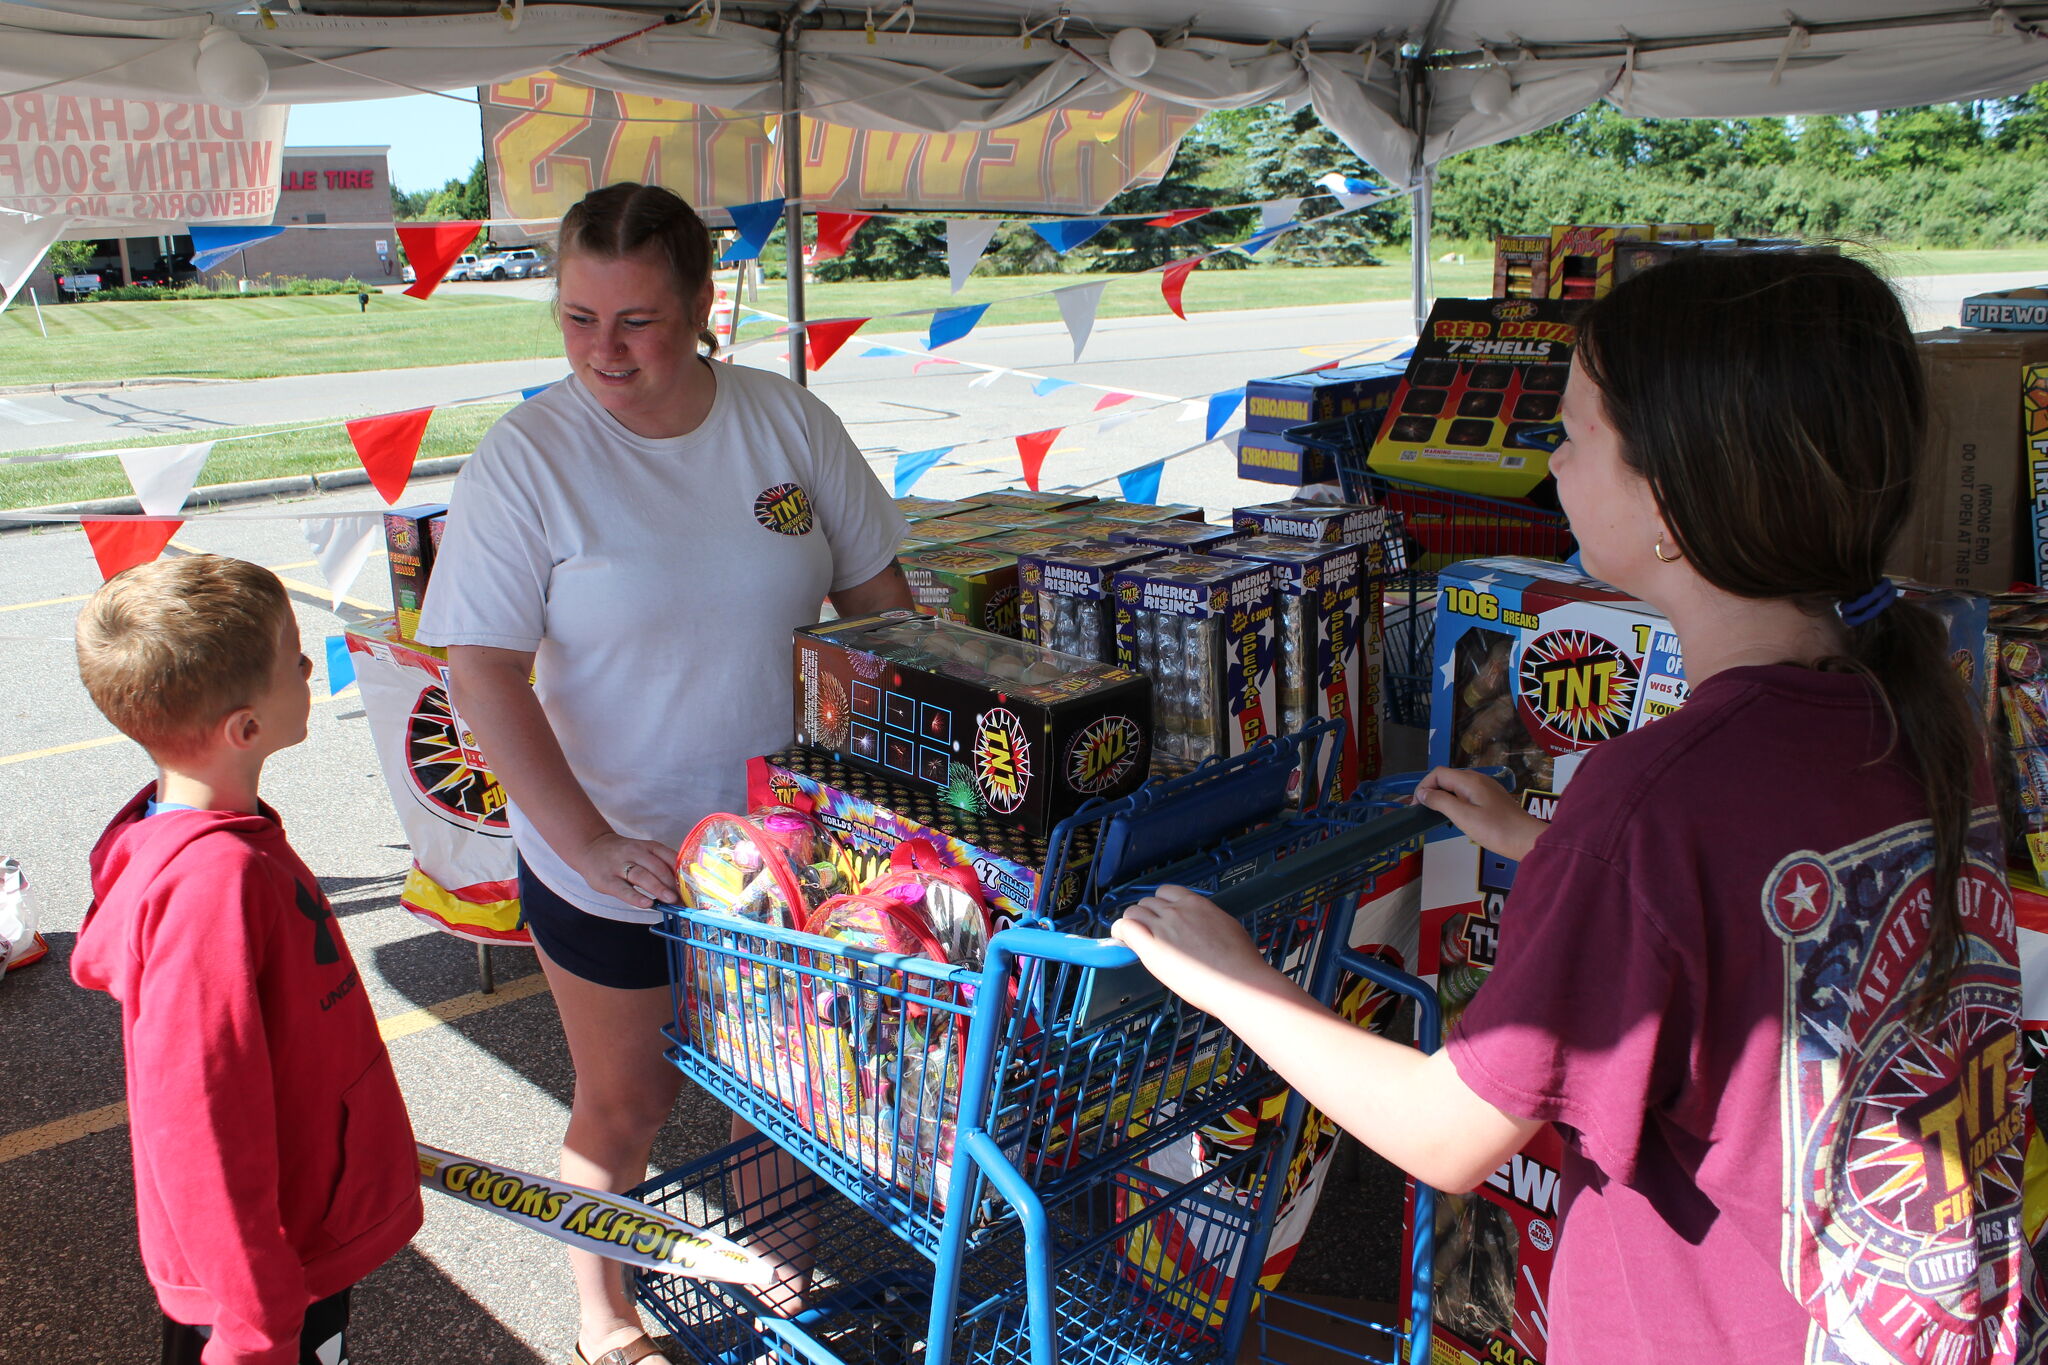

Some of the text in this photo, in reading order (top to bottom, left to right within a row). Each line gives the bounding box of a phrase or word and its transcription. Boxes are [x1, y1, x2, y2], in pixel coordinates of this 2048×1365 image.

[324, 169, 374, 190] TIRE
[1501, 239, 1545, 252] DOUBLE BREAK
[1502, 307, 1527, 318] TNT
[1434, 320, 1577, 346] RED DEVIL
[1250, 396, 1309, 422] FIREWORKS
[1241, 447, 1299, 473] FIREWORKS
[1963, 443, 1976, 462] DO
[1962, 465, 1975, 492] NOT
[771, 488, 805, 524] TNT
[1959, 494, 1973, 530] OPEN
[1263, 518, 1319, 539] AMERICA
[1343, 509, 1384, 533] AMERICA
[1974, 483, 1992, 565] (WRONG END)
[397, 531, 409, 544] TNT
[1343, 526, 1383, 545] RISING
[1959, 534, 1972, 547] AT
[390, 551, 421, 567] FESTIVAL
[1323, 551, 1358, 573] AMERICA
[1957, 548, 1970, 576] THIS
[394, 563, 416, 577] BALLS
[905, 571, 932, 586] MOOD
[1025, 569, 1039, 579] TNT
[1044, 565, 1091, 584] AMERICA
[1307, 573, 1320, 587] TNT
[1323, 565, 1356, 585] RISING
[1044, 578, 1089, 595] RISING
[1121, 586, 1137, 597] TNT
[1144, 583, 1199, 602] AMERICA
[1231, 570, 1271, 594] AMERICA
[919, 588, 949, 604] RINGS
[1212, 594, 1228, 610] TNT
[1231, 585, 1270, 607] RISING
[1343, 587, 1359, 599] SHOT
[1143, 595, 1196, 615] RISING
[1250, 613, 1256, 623] 6
[1256, 606, 1273, 622] SHOT
[1444, 587, 1499, 621] 106
[994, 600, 1020, 630] TN
[1368, 581, 1380, 655] SPECIAL
[1502, 610, 1540, 631] BREAKS
[1121, 634, 1133, 643] SHOT
[1331, 609, 1346, 684] SPECIAL
[1242, 631, 1261, 710] SPECIAL
[1665, 655, 1683, 675] OF
[1540, 660, 1618, 715] TNT
[1650, 680, 1673, 694] was
[985, 729, 1017, 794] TNT
[1082, 727, 1126, 782] TNT
[777, 787, 798, 805] TNT
[821, 814, 852, 832] WORLD'S
[973, 859, 1000, 890] 47
[1000, 871, 1030, 898] KILLER
[1000, 884, 1029, 909] SHOTS!
[1863, 952, 1890, 1005] IF
[1886, 886, 1934, 962] IT'S
[1956, 876, 1987, 919] OT
[1919, 1031, 2017, 1193] TNT
[443, 1162, 570, 1222] SWORD
[560, 1202, 711, 1268] MIGHTY
[1530, 1230, 1550, 1245] GRADE
[1535, 1223, 1547, 1236] PRO
[1880, 1294, 1937, 1358] IT'S
[1433, 1338, 1461, 1358] RNING
